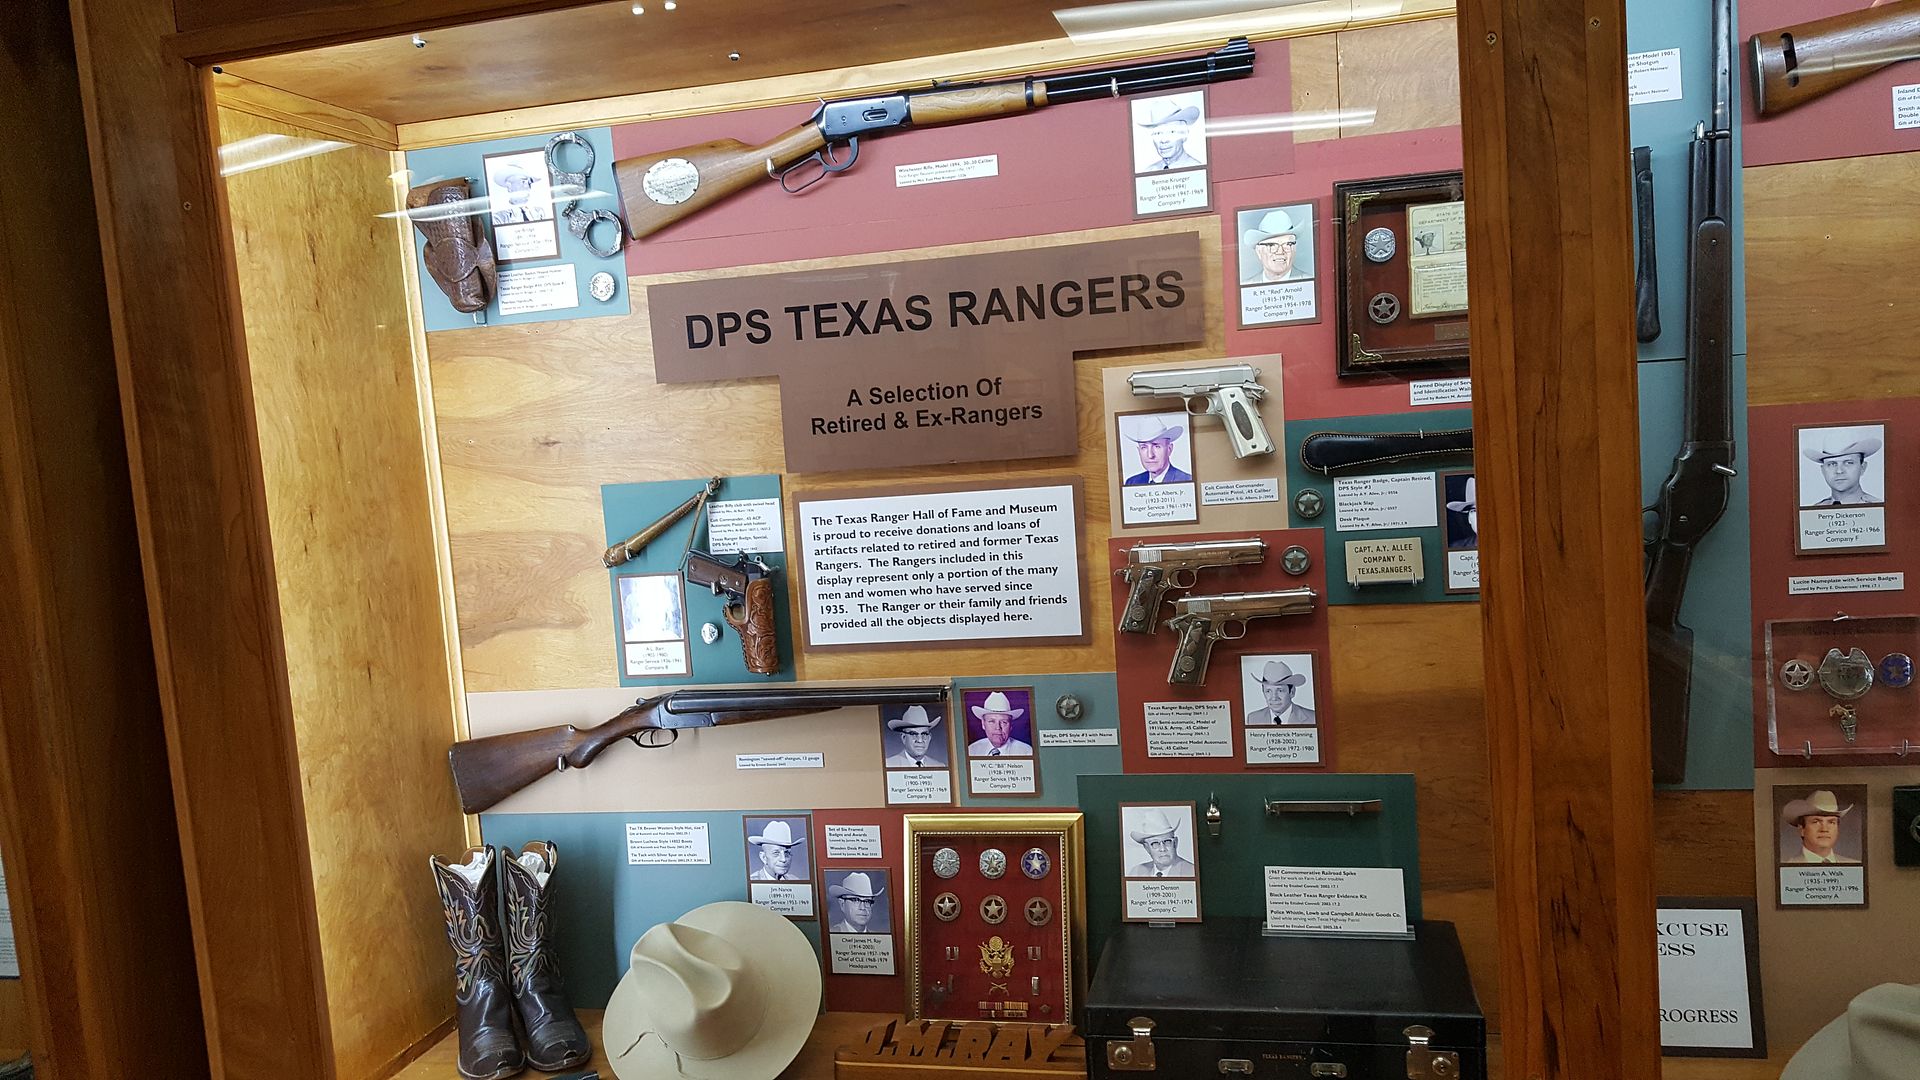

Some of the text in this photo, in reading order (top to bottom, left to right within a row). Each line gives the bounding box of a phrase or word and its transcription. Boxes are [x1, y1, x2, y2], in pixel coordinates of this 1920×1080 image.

[686, 270, 1185, 349] DPS TEXAS RANGERS
[847, 377, 1002, 407] A Selection Of
[812, 405, 1043, 435] Retired & Ex-Rangers
[812, 504, 1057, 526] The Texas Ranger Hall of Fame and Museum
[813, 532, 821, 541] is
[824, 530, 856, 543] proud
[874, 527, 913, 537] receive
[916, 524, 970, 535] donations
[973, 521, 994, 532] and
[997, 521, 1026, 530] loans
[1030, 518, 1040, 528] of
[814, 546, 858, 556] artifacts
[861, 542, 900, 553] related
[918, 539, 956, 550] retired
[960, 537, 980, 548] and
[983, 537, 1022, 546] former
[1025, 534, 1059, 544] Texas
[816, 550, 1023, 572] Rangers. The Rangers included in this
[1363, 555, 1395, 564] COMPANY
[817, 575, 853, 587] display
[856, 573, 909, 585] represent
[912, 570, 934, 582] only
[948, 568, 988, 581] portion
[992, 566, 1003, 576] of
[1005, 566, 1024, 576] the
[1028, 567, 1058, 576] many
[845, 589, 864, 599] and
[910, 586, 933, 595] who
[936, 585, 962, 594] have
[965, 582, 1001, 593] served
[1004, 581, 1032, 591] since
[821, 605, 848, 614] 1935.
[857, 603, 878, 613] The
[882, 602, 921, 613] Ranger
[939, 599, 966, 609] their
[969, 597, 1002, 610] family
[1005, 596, 1025, 606] and
[1029, 594, 1067, 605] friends
[821, 612, 1032, 632] provided all the objects displayed here.
